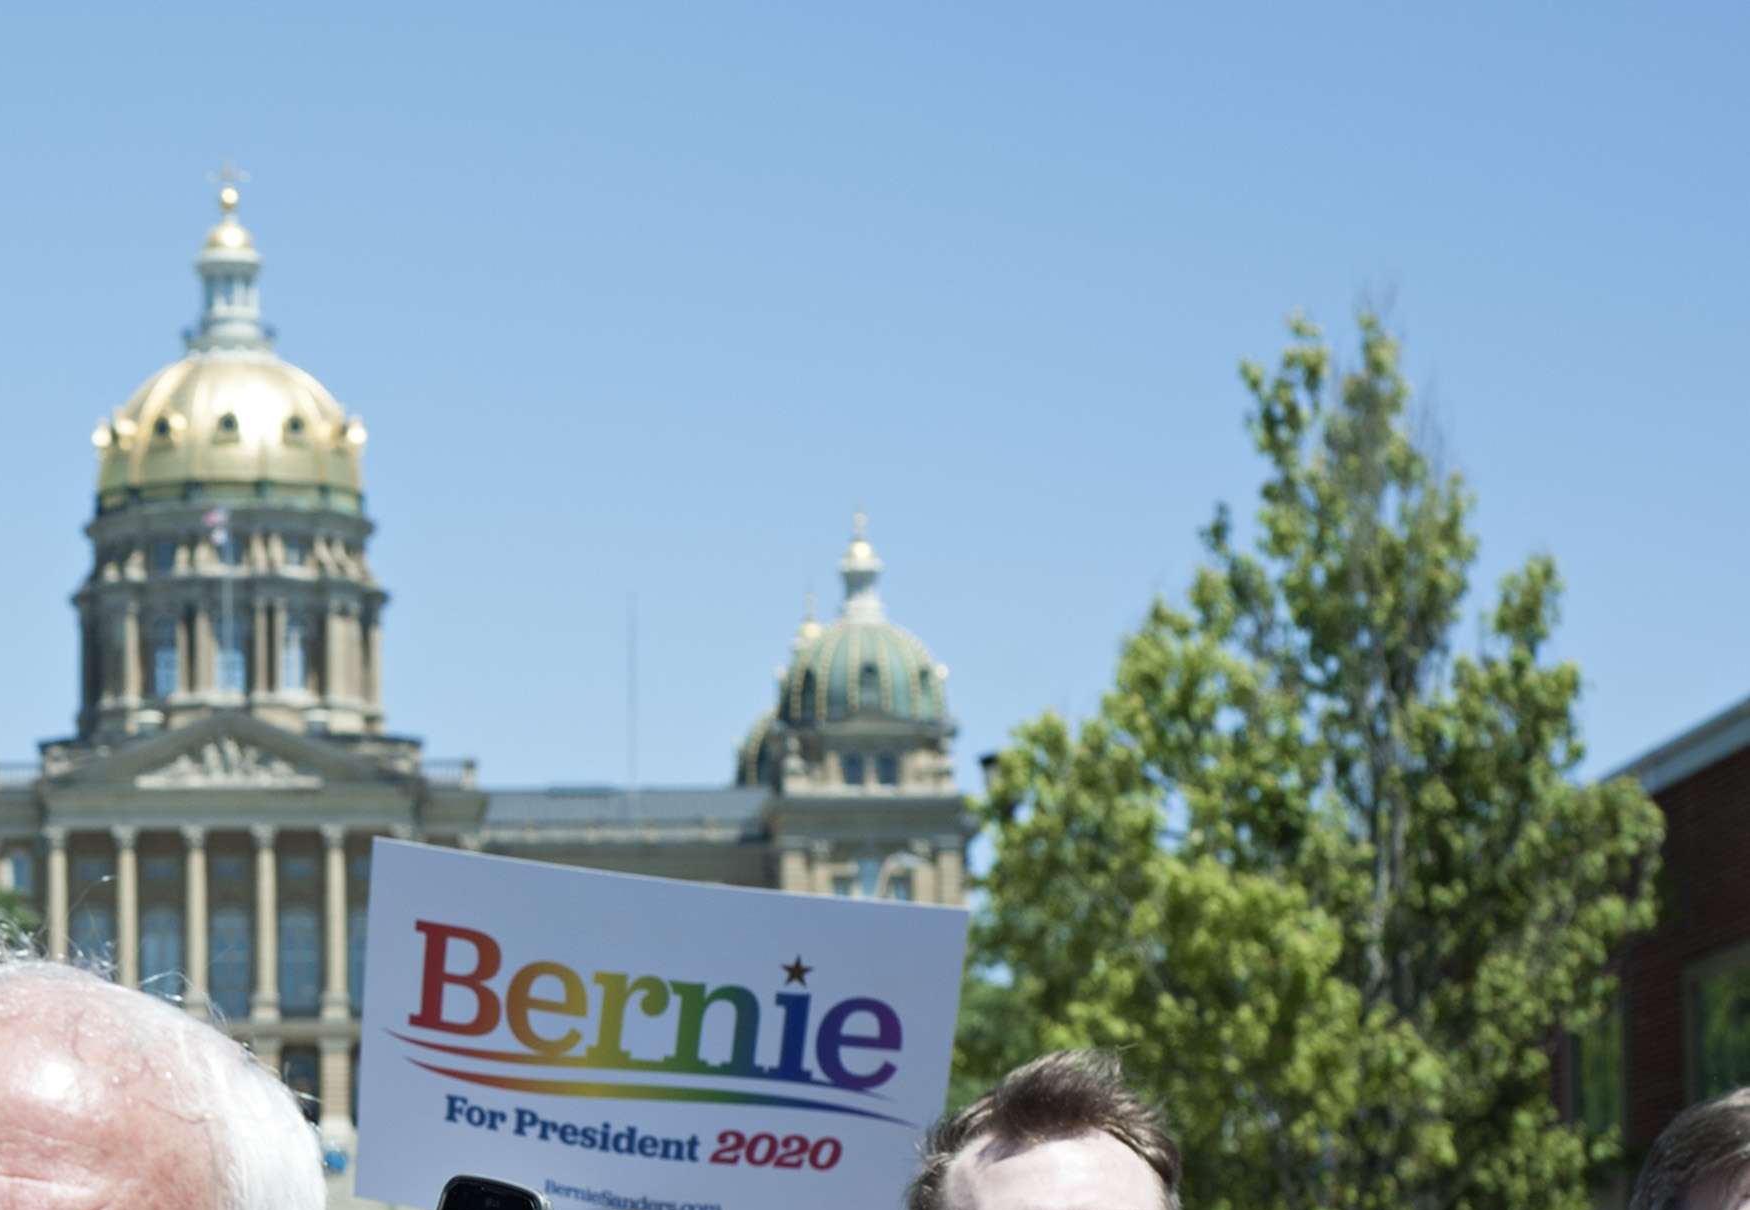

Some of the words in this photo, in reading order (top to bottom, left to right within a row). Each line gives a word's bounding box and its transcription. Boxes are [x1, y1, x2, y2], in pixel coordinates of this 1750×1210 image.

[408, 919, 903, 1091] Bernie
[445, 1095, 507, 1131] For
[513, 1107, 700, 1163] President
[709, 1129, 842, 1171] 2020
